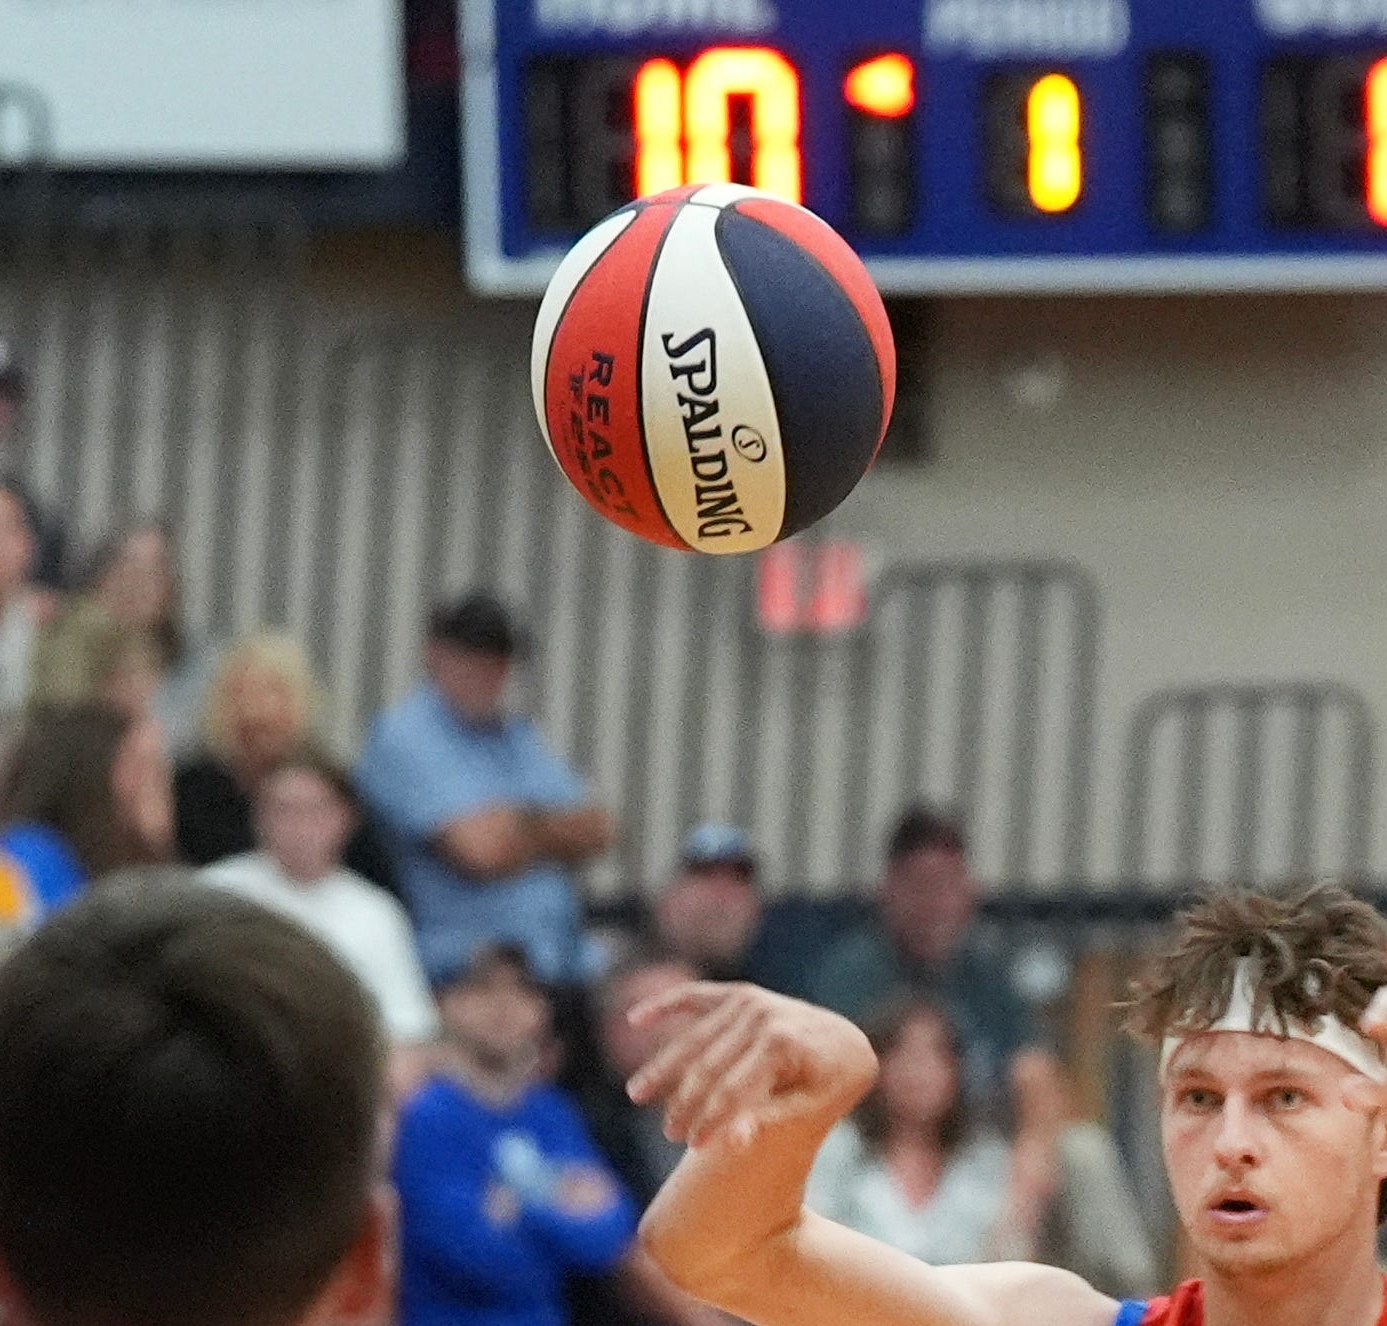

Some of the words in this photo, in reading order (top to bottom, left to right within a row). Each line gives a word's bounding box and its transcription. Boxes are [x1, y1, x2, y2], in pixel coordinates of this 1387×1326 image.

[1026, 73, 1083, 213] 1
[588, 350, 643, 518] REACT
[661, 327, 754, 539] SPALDING
